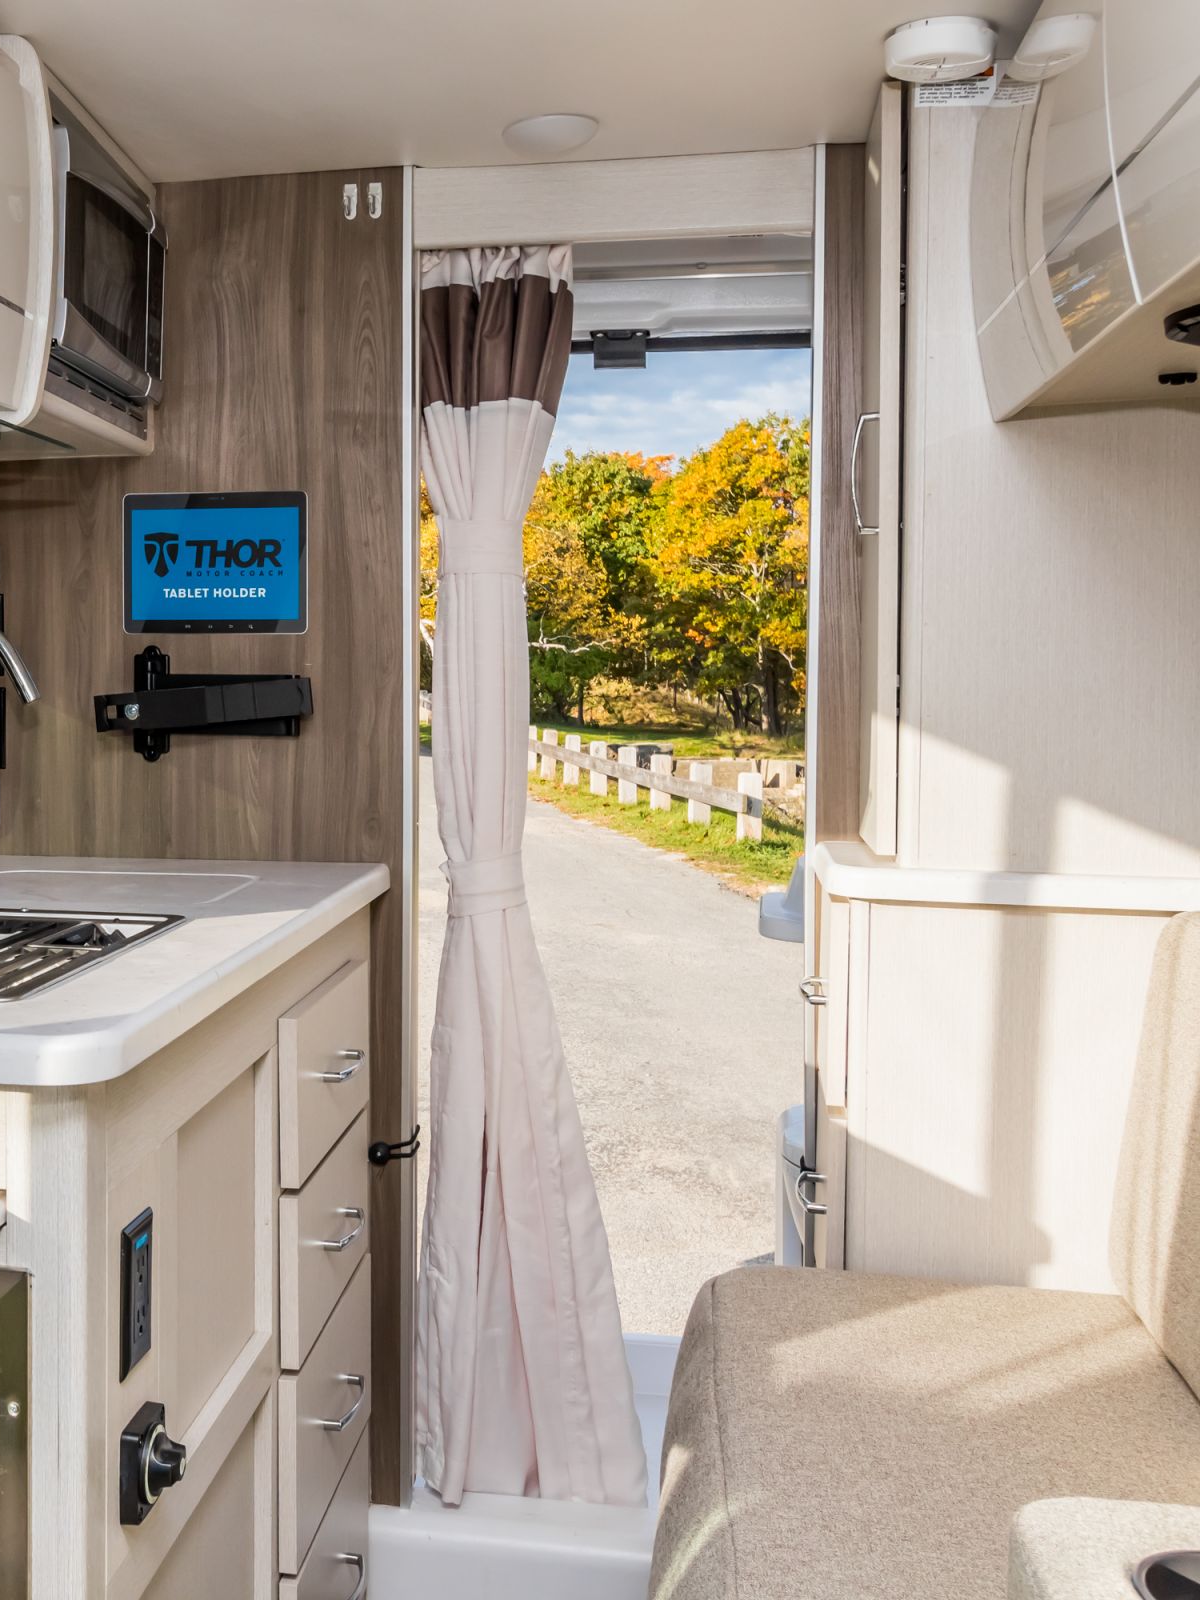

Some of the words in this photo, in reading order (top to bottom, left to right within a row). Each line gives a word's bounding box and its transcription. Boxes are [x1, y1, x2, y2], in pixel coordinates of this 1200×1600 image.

[185, 539, 282, 568] THOR
[163, 588, 209, 598] TABLET
[213, 588, 266, 598] HOLDER
